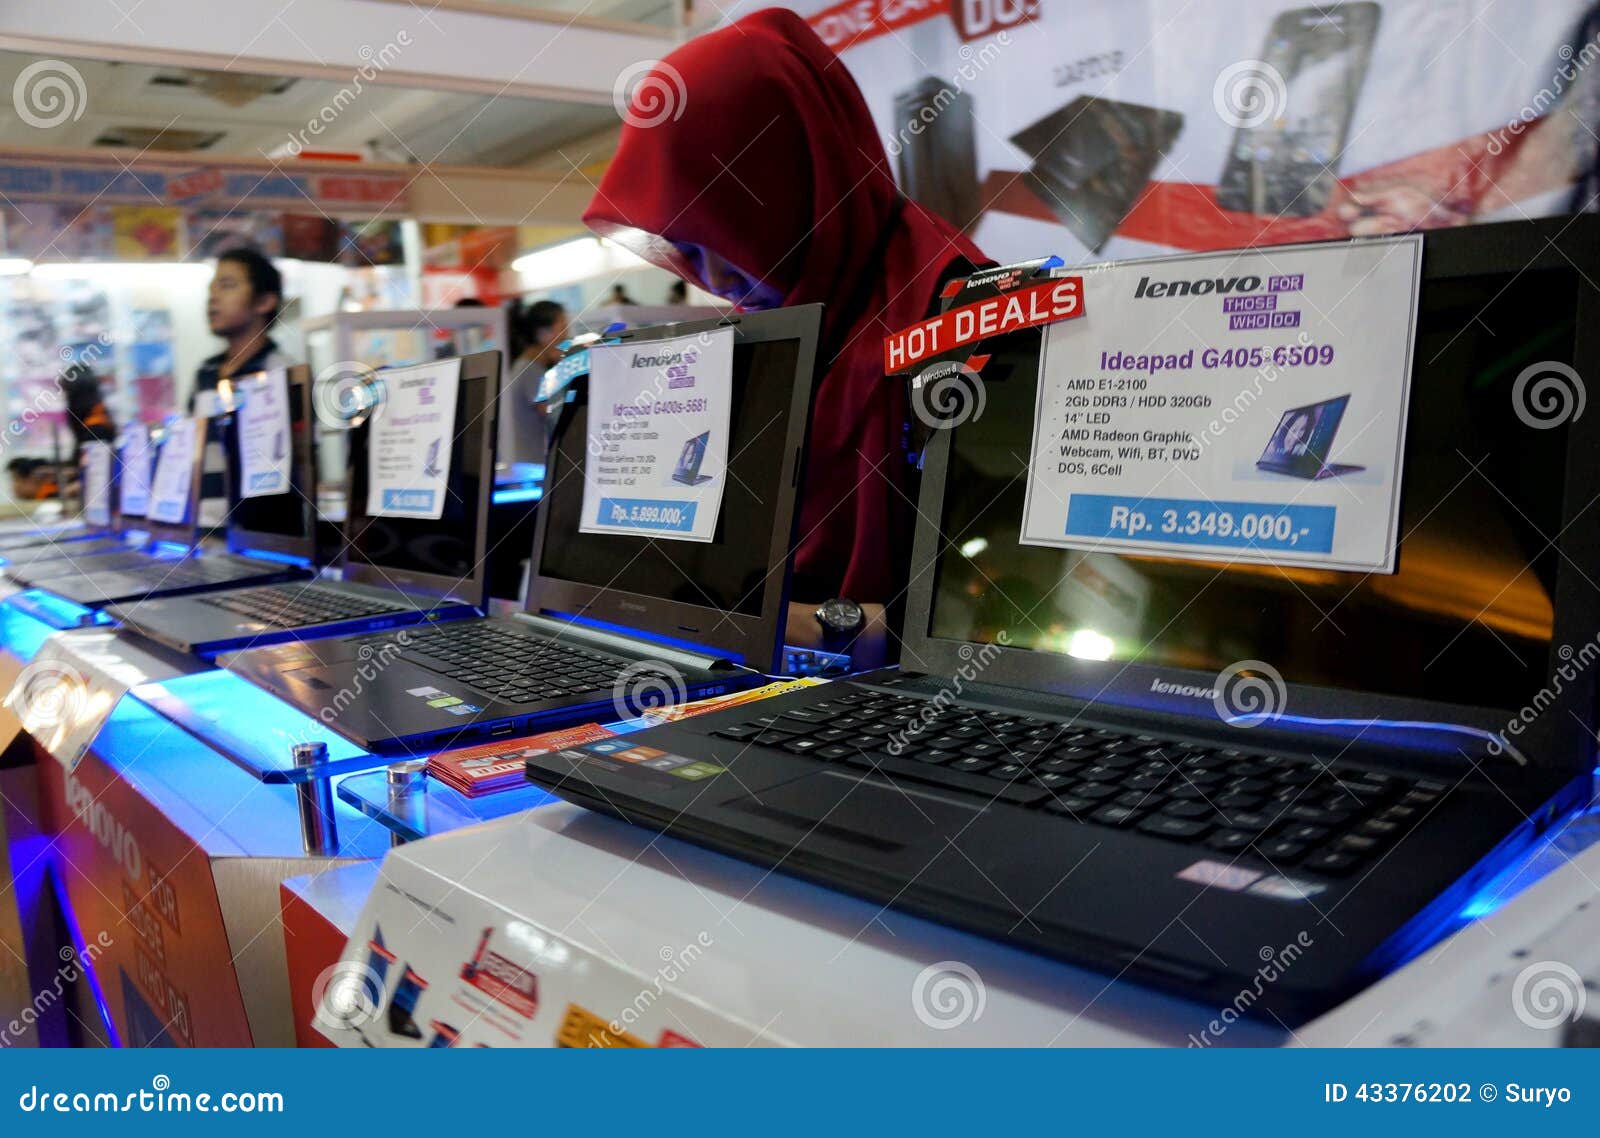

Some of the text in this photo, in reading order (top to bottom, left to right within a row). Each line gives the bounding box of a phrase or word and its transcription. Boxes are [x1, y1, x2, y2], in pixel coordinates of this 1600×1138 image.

[966, 272, 1010, 289] lenovo
[1134, 276, 1301, 299] lenovo FOR
[1225, 297, 1276, 312] THOSE
[889, 282, 1078, 369] HOT DEALS
[1232, 315, 1268, 329] WHO
[1101, 344, 1335, 375] Ideapad G405-6509
[1066, 378, 1148, 391] AMD E1-2100
[1064, 395, 1090, 408] 2Gb
[1092, 395, 1128, 408] DDR3
[1138, 395, 1168, 408] HDD
[1169, 394, 1213, 408] 320Gb
[1085, 412, 1111, 424] LED
[1061, 429, 1193, 446] AMD Radeon Graphic
[1060, 446, 1201, 463] Webcam, Wifi, BT, DVD
[1057, 462, 1123, 476] DOS, 6Cell
[611, 505, 687, 524] Rp. 5.899.000,-
[1110, 506, 1310, 546] Rp. 3.349.000,-
[1150, 677, 1220, 700] lenovo
[64, 768, 141, 881] lenovo
